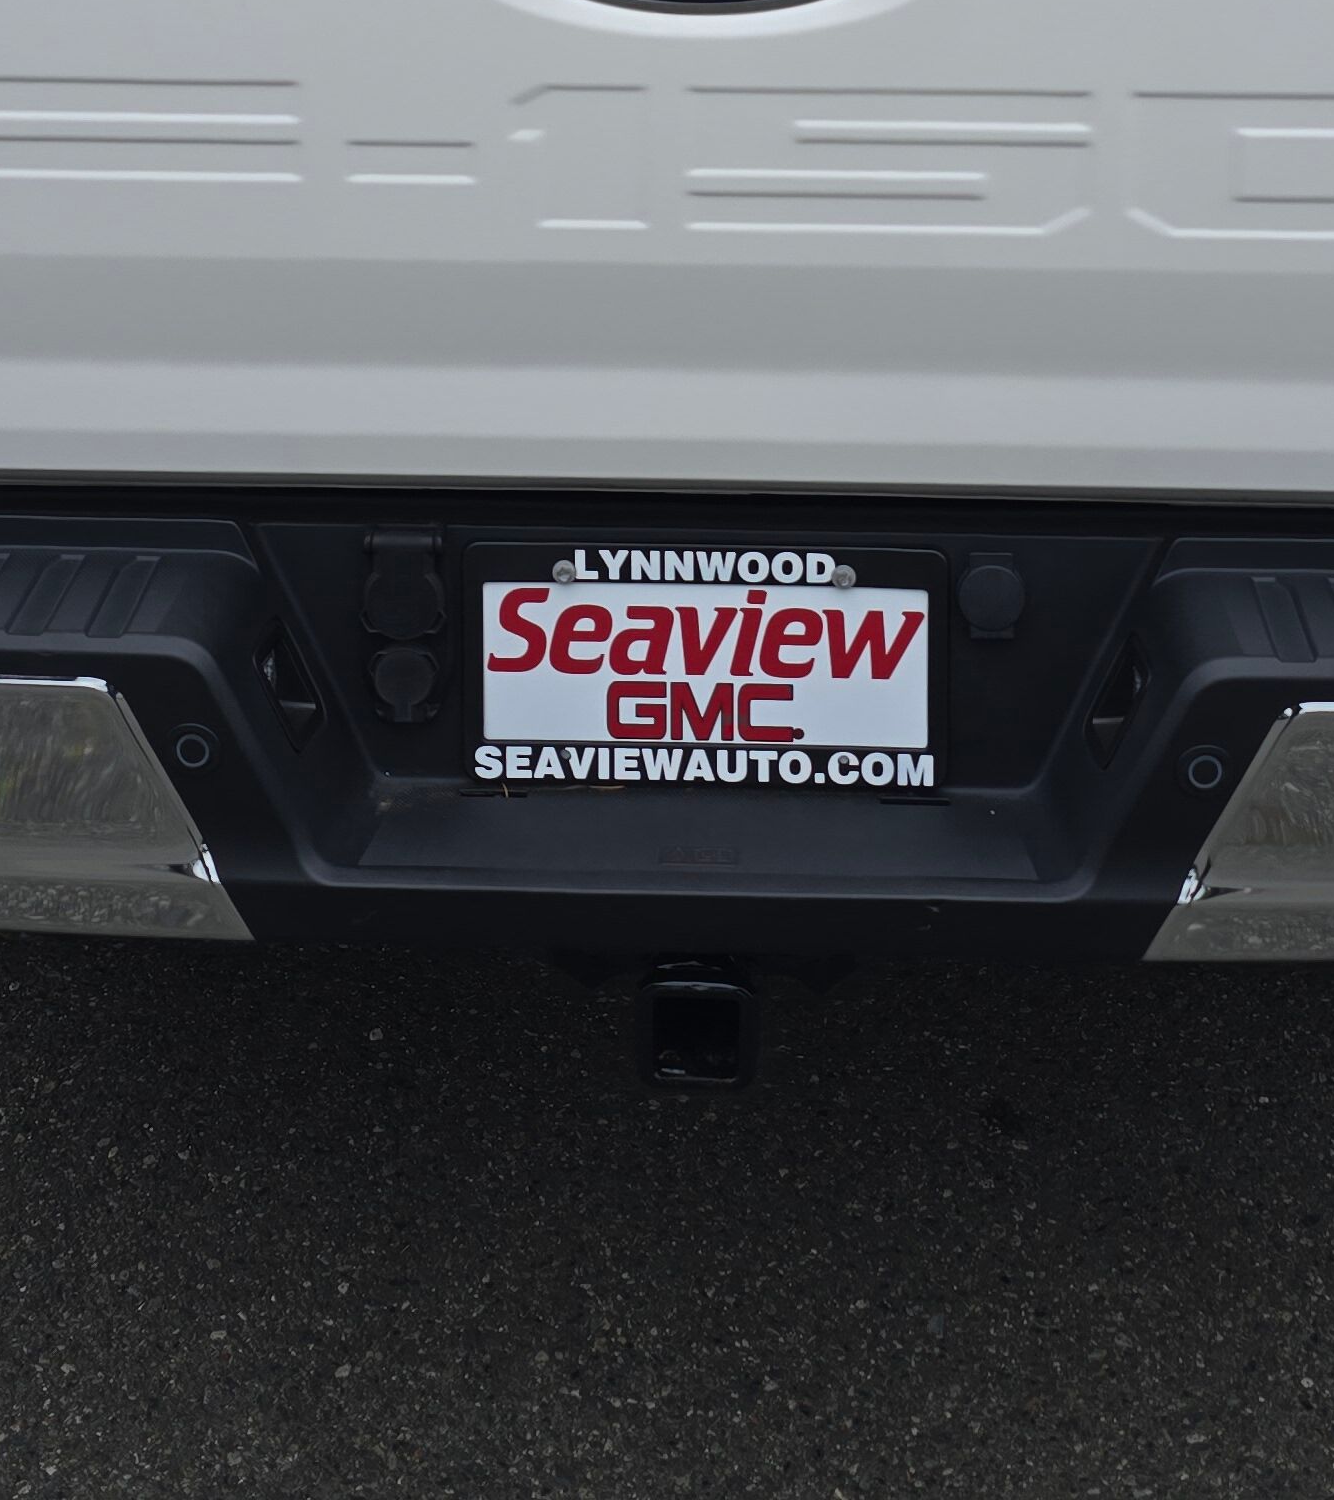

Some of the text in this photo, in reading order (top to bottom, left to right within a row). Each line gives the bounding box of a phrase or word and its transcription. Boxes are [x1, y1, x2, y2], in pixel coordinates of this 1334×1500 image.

[575, 549, 836, 583] LYNNWOOD
[486, 587, 926, 680] Seaview
[606, 681, 795, 742] GMC
[473, 745, 934, 787] SEAVIEWAUTO.COM
